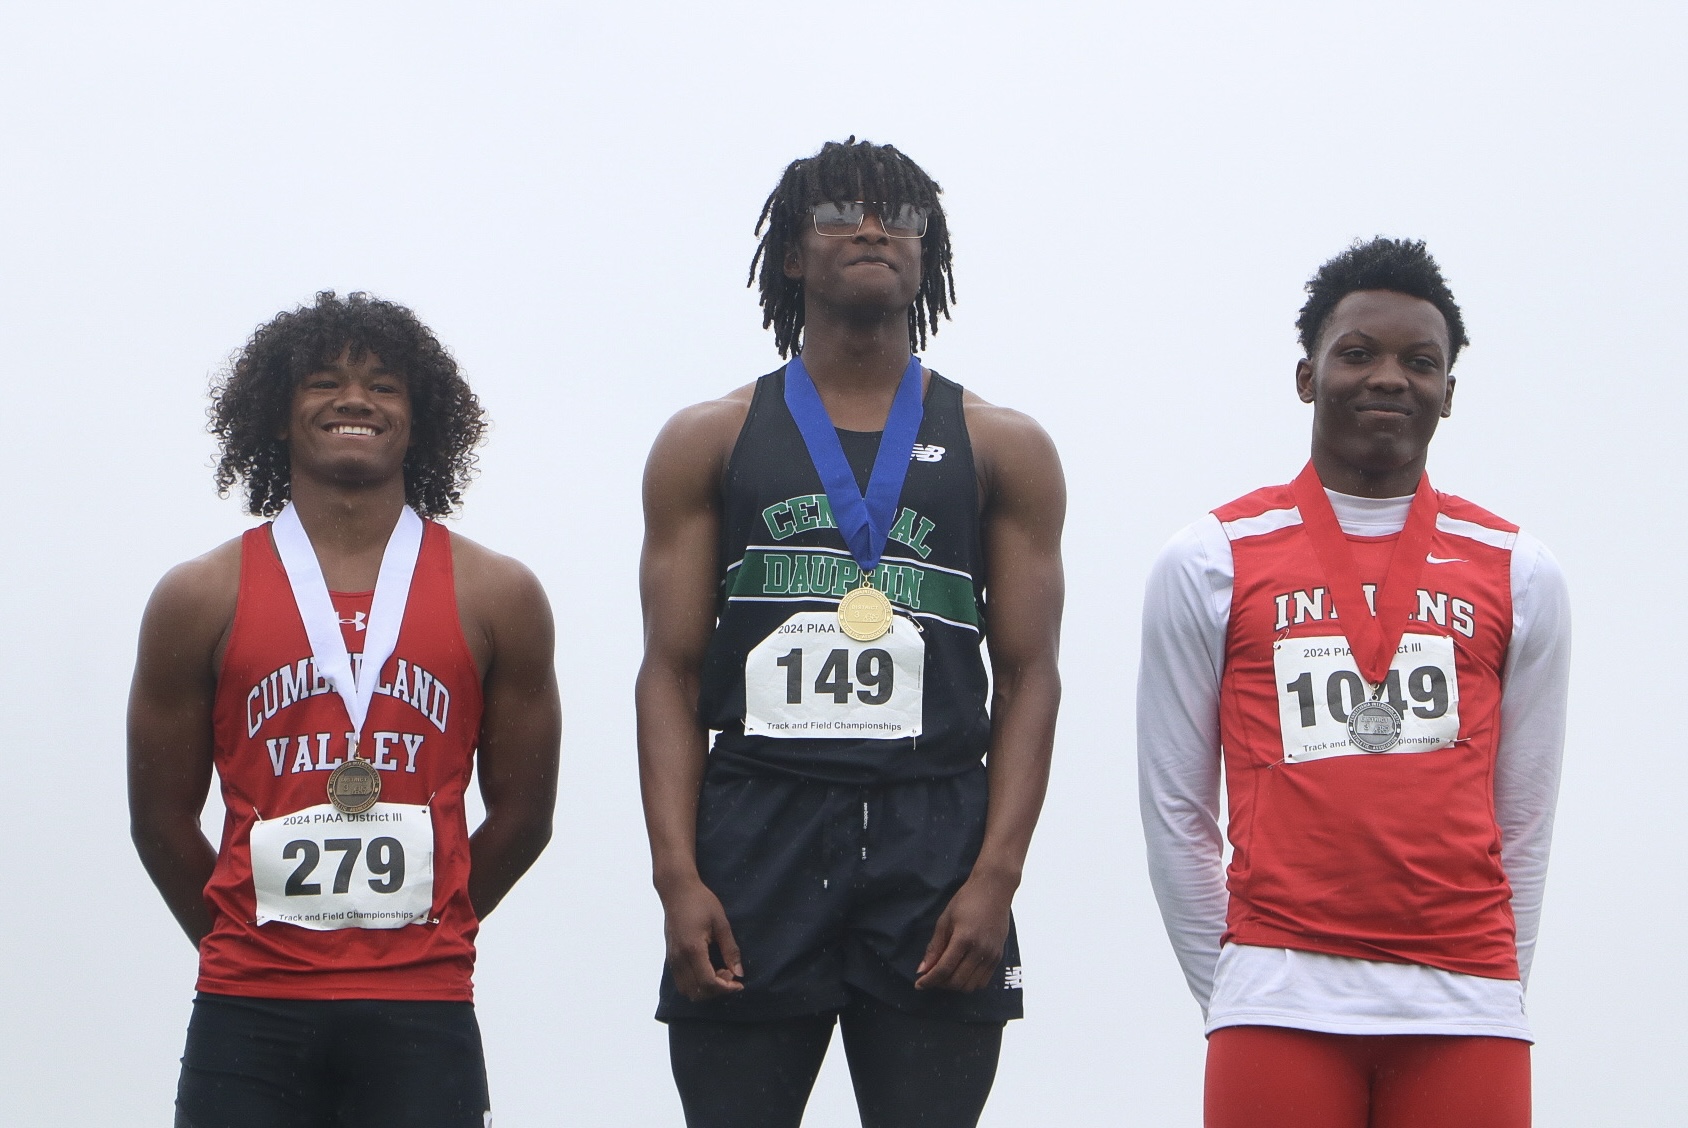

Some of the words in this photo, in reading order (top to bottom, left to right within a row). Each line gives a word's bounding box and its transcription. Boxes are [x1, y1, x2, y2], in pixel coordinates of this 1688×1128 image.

[762, 494, 936, 559] CENAL
[778, 624, 804, 634] 2024
[807, 624, 836, 633] PIAA
[1303, 648, 1331, 658] 2024
[1334, 647, 1353, 657] PIA
[1411, 643, 1422, 653] III
[776, 648, 894, 706] 149
[1286, 665, 1449, 728] 1049
[767, 722, 790, 730] Track
[792, 722, 808, 730] and
[810, 721, 832, 730] Field
[834, 722, 902, 731] Championships
[1303, 743, 1328, 753] Track
[1329, 739, 1346, 749] and
[1398, 736, 1440, 745] pionships
[265, 731, 424, 777] VALLEY
[283, 815, 311, 825] 2024
[314, 812, 343, 823] PIAA
[347, 812, 390, 823] District
[392, 813, 402, 822] III
[282, 836, 405, 897] 279
[279, 913, 303, 922] Track
[305, 912, 320, 921] and
[322, 911, 344, 921] Field
[346, 910, 414, 921] Championships
